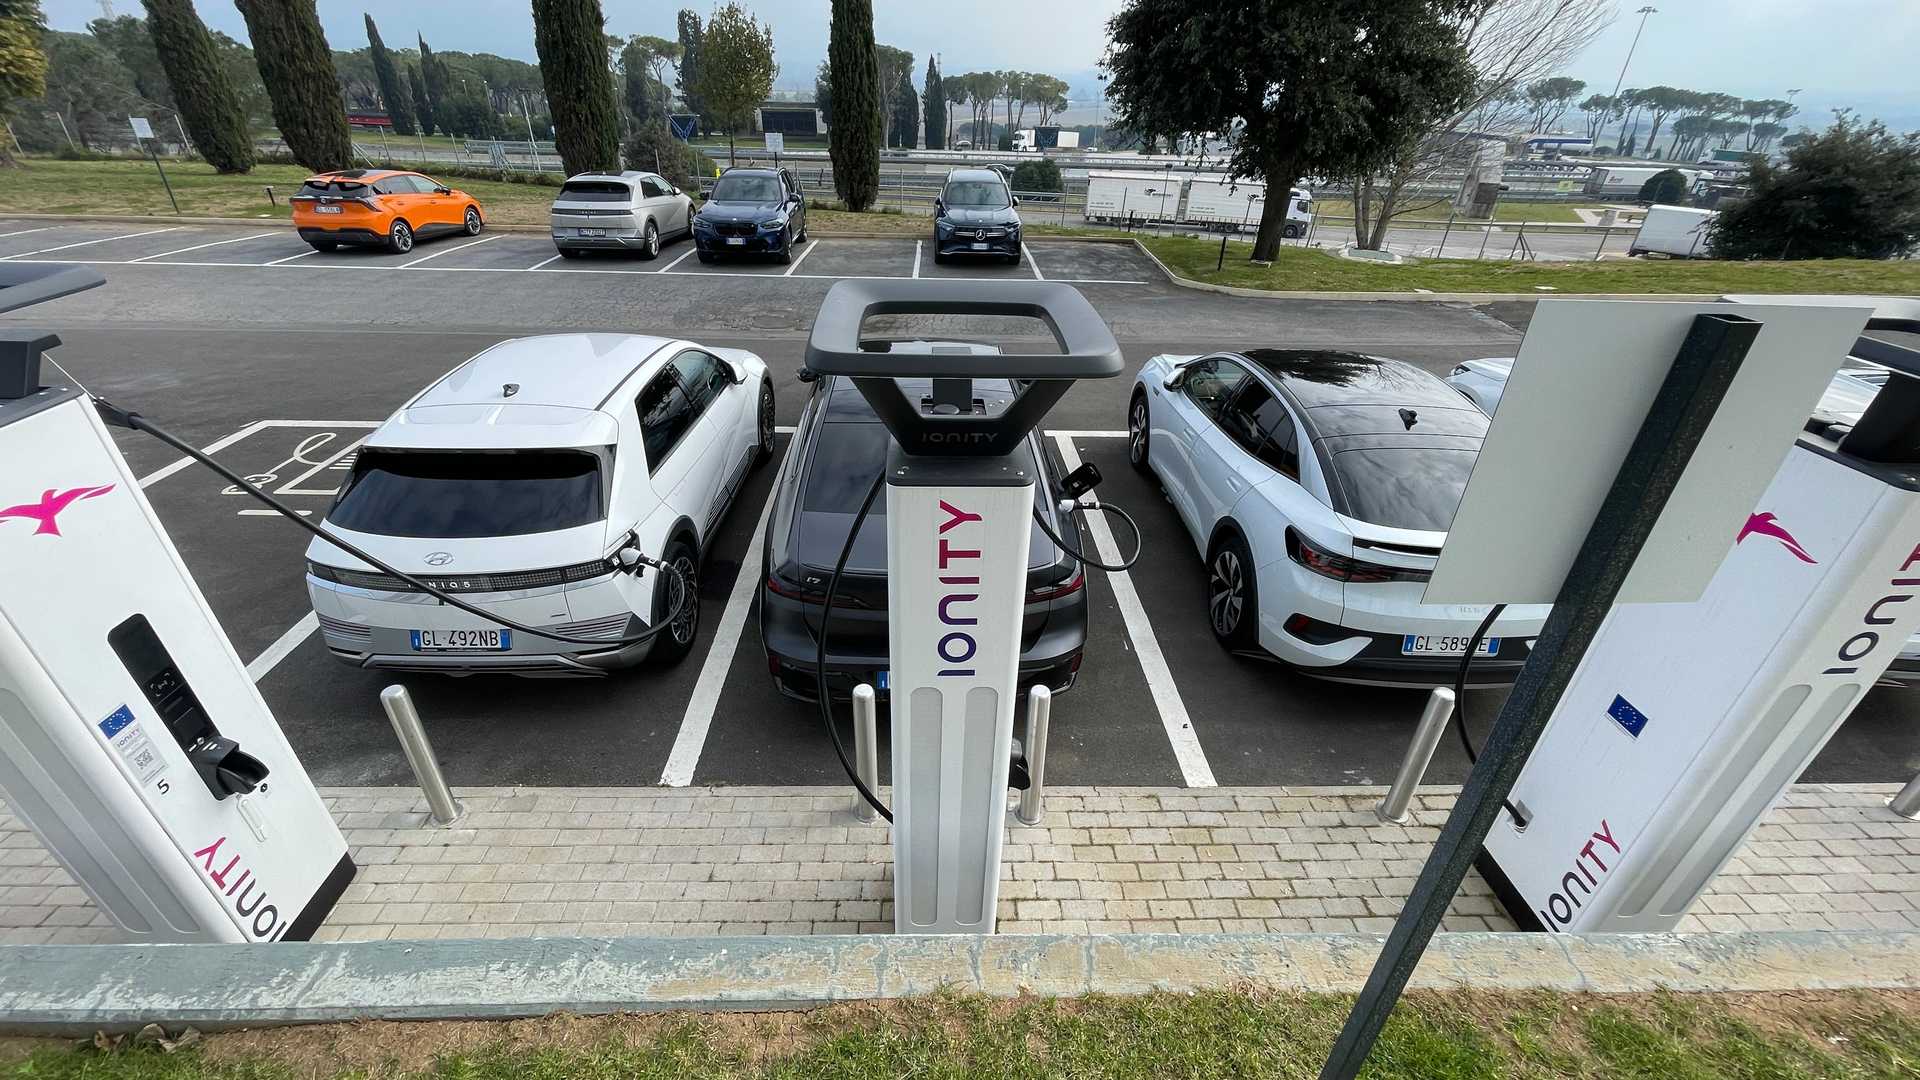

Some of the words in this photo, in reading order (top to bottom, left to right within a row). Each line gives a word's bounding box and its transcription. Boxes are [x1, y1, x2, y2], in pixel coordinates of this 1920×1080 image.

[921, 432, 999, 444] IONITY
[937, 499, 983, 677] IONITY
[448, 630, 499, 647] 492NB
[1440, 636, 1488, 652] 589E
[157, 778, 170, 796] 5
[1540, 818, 1621, 934] IONITY
[193, 836, 287, 943] IONITY
